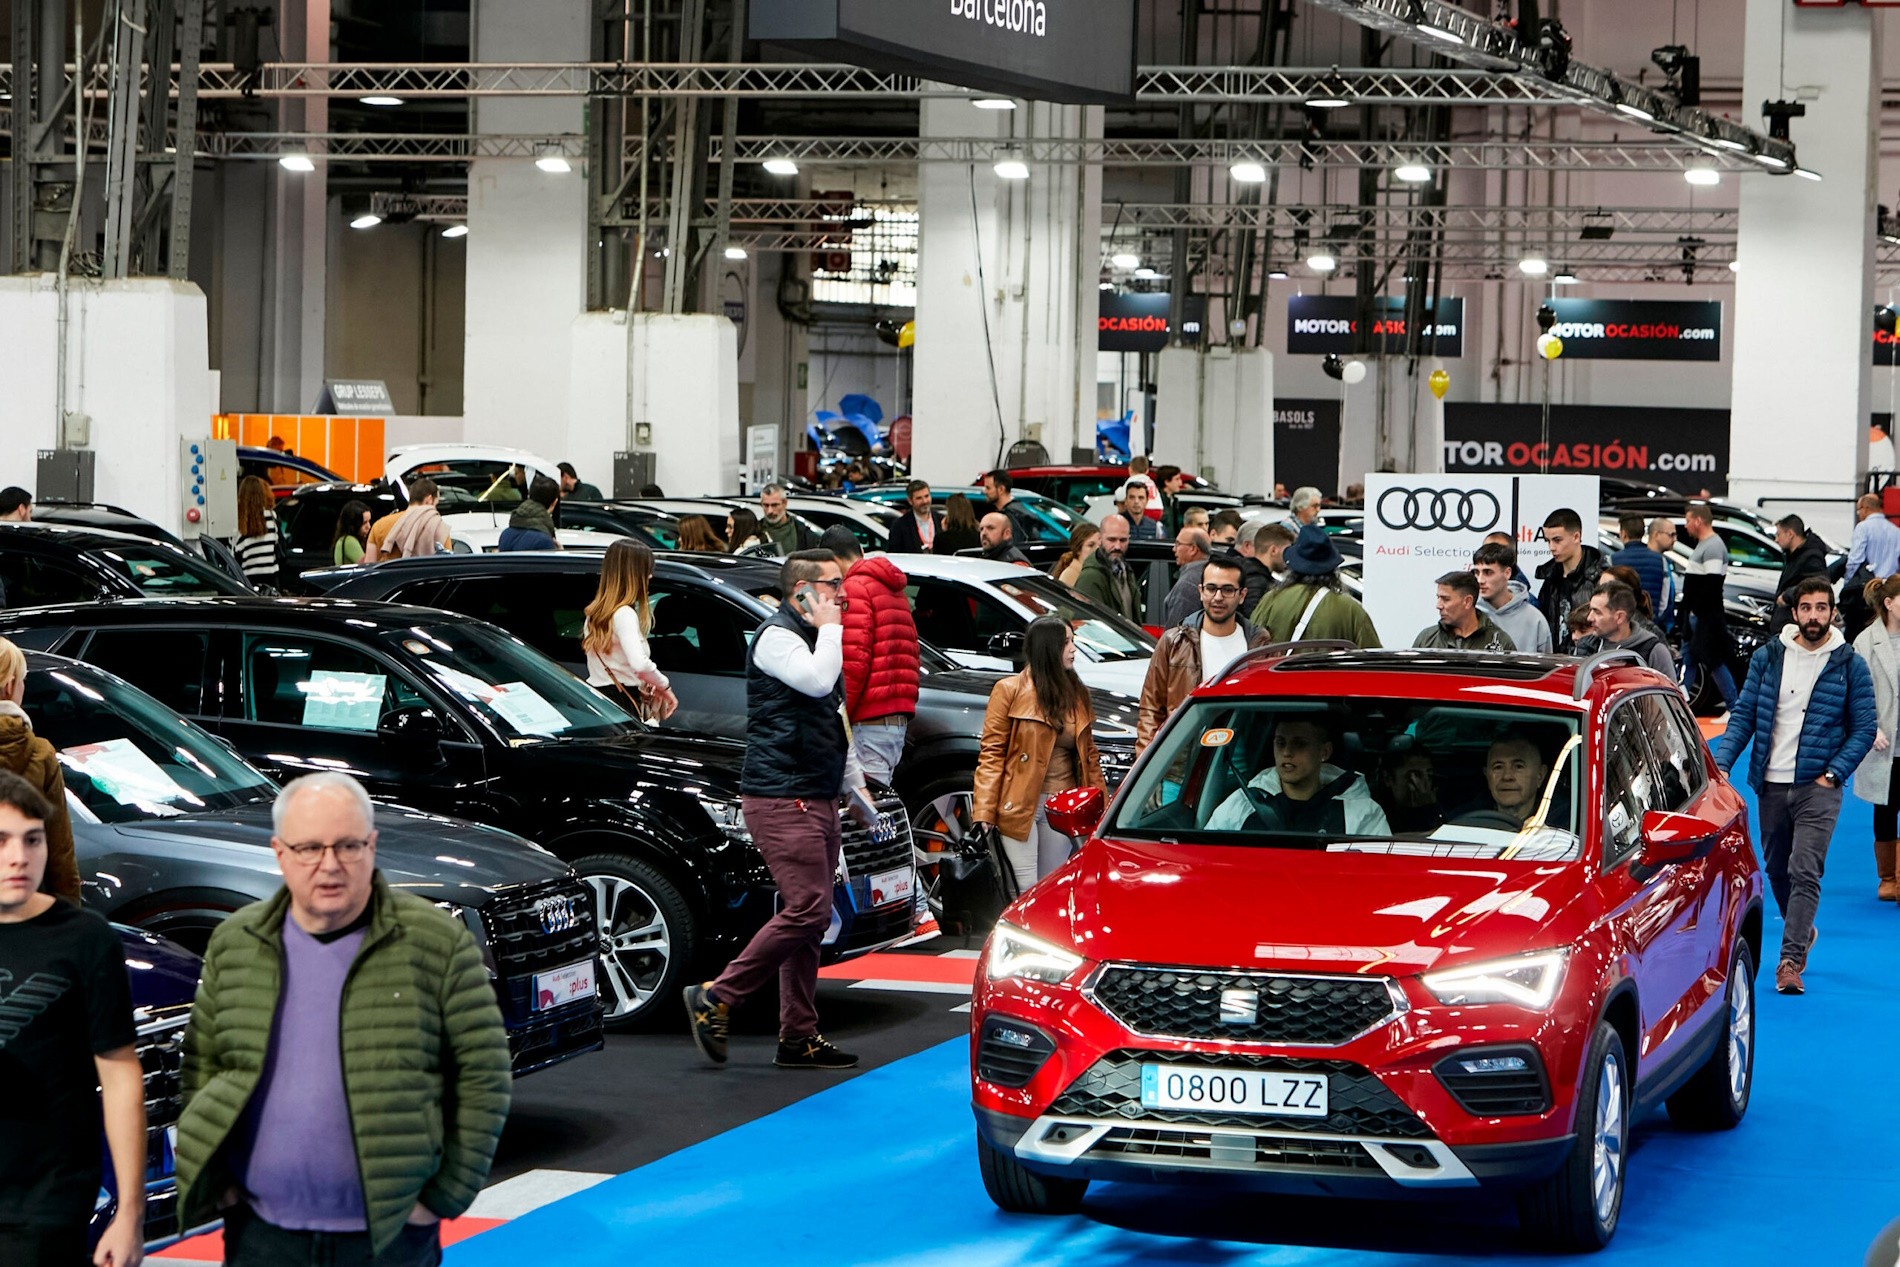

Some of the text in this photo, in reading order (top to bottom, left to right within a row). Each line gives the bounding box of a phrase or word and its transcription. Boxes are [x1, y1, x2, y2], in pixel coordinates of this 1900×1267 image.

[1273, 410, 1315, 423] BASOLS
[1376, 544, 1410, 556] Audi
[1167, 1073, 1323, 1109] 0800 LZZ
